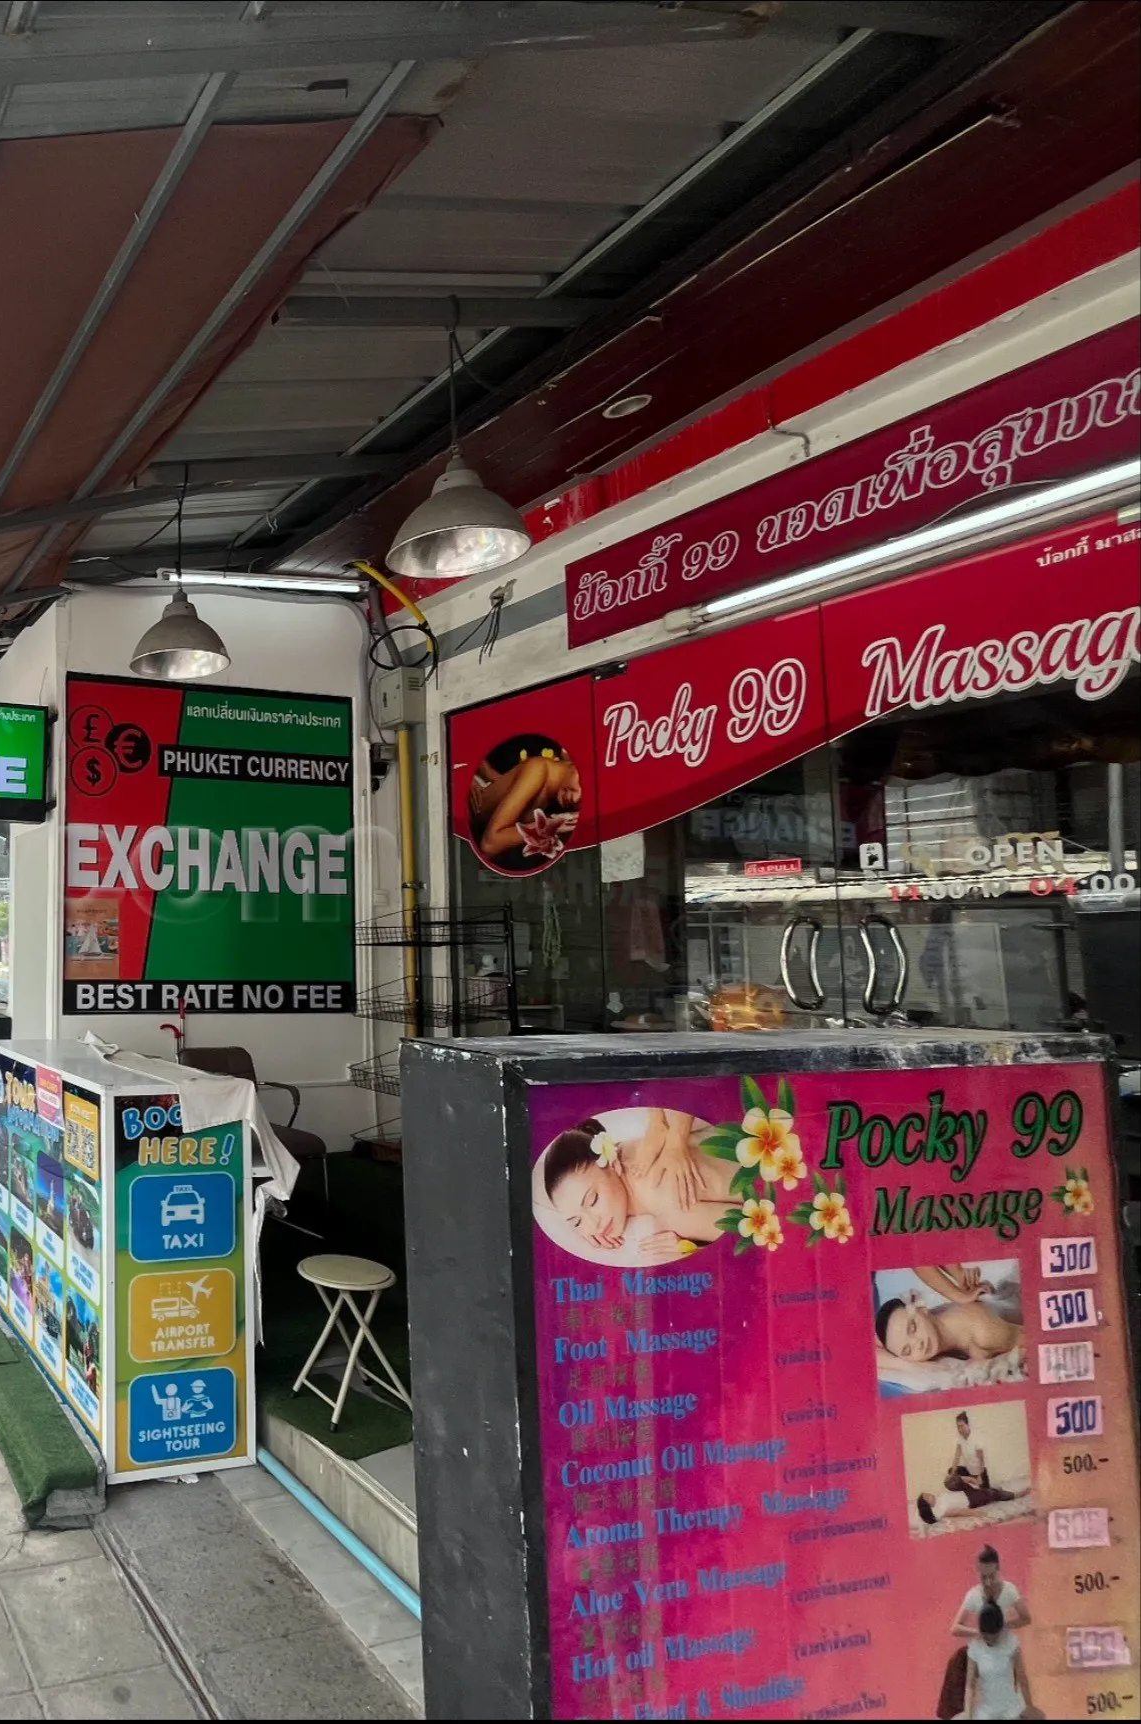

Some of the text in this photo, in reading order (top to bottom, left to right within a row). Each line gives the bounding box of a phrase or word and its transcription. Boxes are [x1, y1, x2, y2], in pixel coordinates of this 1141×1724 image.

[682, 530, 739, 581] 99
[603, 606, 1140, 767] Pocky 99 Massag
[164, 750, 349, 782] PHUKET CURRENCY
[67, 822, 348, 895] EXCHANGE
[766, 863, 797, 872] PULL
[966, 839, 1064, 867] OPEN
[76, 984, 342, 1009] BEST RATE NO FEE
[122, 1103, 183, 1140] BOO
[820, 1089, 1083, 1182] Pocky 99
[138, 1134, 235, 1166] HERE!
[869, 1186, 1043, 1241] Massage
[162, 1233, 204, 1250] TAXI
[1049, 1241, 1092, 1274] 300
[551, 1271, 713, 1303] Thai Massage
[1046, 1291, 1089, 1329] 300
[150, 1335, 215, 1353] TRANSFER
[155, 1323, 210, 1339] AIRPORT
[554, 1327, 718, 1364] Foot Massage
[559, 1393, 698, 1429] Oil Massage
[1055, 1399, 1098, 1435] 500
[138, 1421, 226, 1442] SIGHTSEEING
[165, 1438, 200, 1452] TOUR
[561, 1453, 654, 1487] Coconut
[662, 1443, 695, 1472] Oil
[702, 1438, 786, 1466] Massage
[567, 1519, 644, 1549] Aroma
[653, 1504, 743, 1535] Therapy
[568, 1589, 625, 1619] Aloe
[633, 1578, 689, 1606] Vera
[572, 1653, 617, 1683] Hot
[626, 1642, 655, 1671] oil
